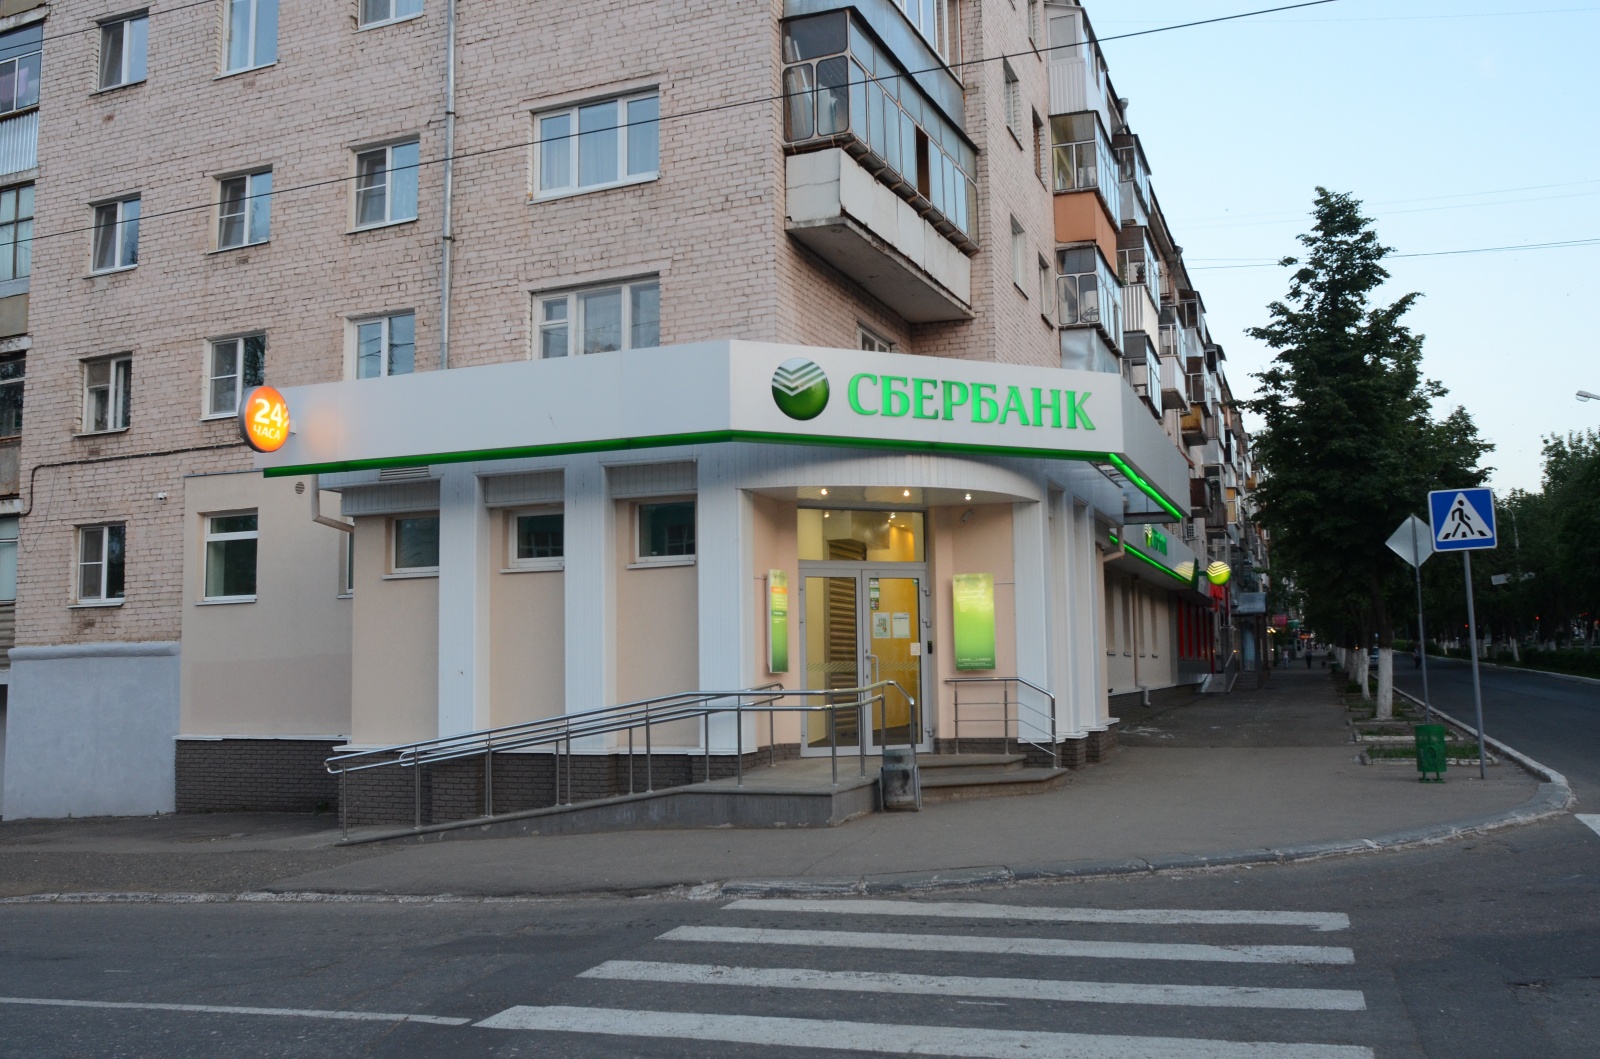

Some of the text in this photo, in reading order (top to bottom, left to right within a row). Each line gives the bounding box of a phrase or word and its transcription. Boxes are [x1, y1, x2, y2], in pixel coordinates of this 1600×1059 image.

[254, 398, 283, 428] 24
[847, 372, 1096, 431] СБЕРБАНК
[253, 424, 281, 441] ЧАСА
